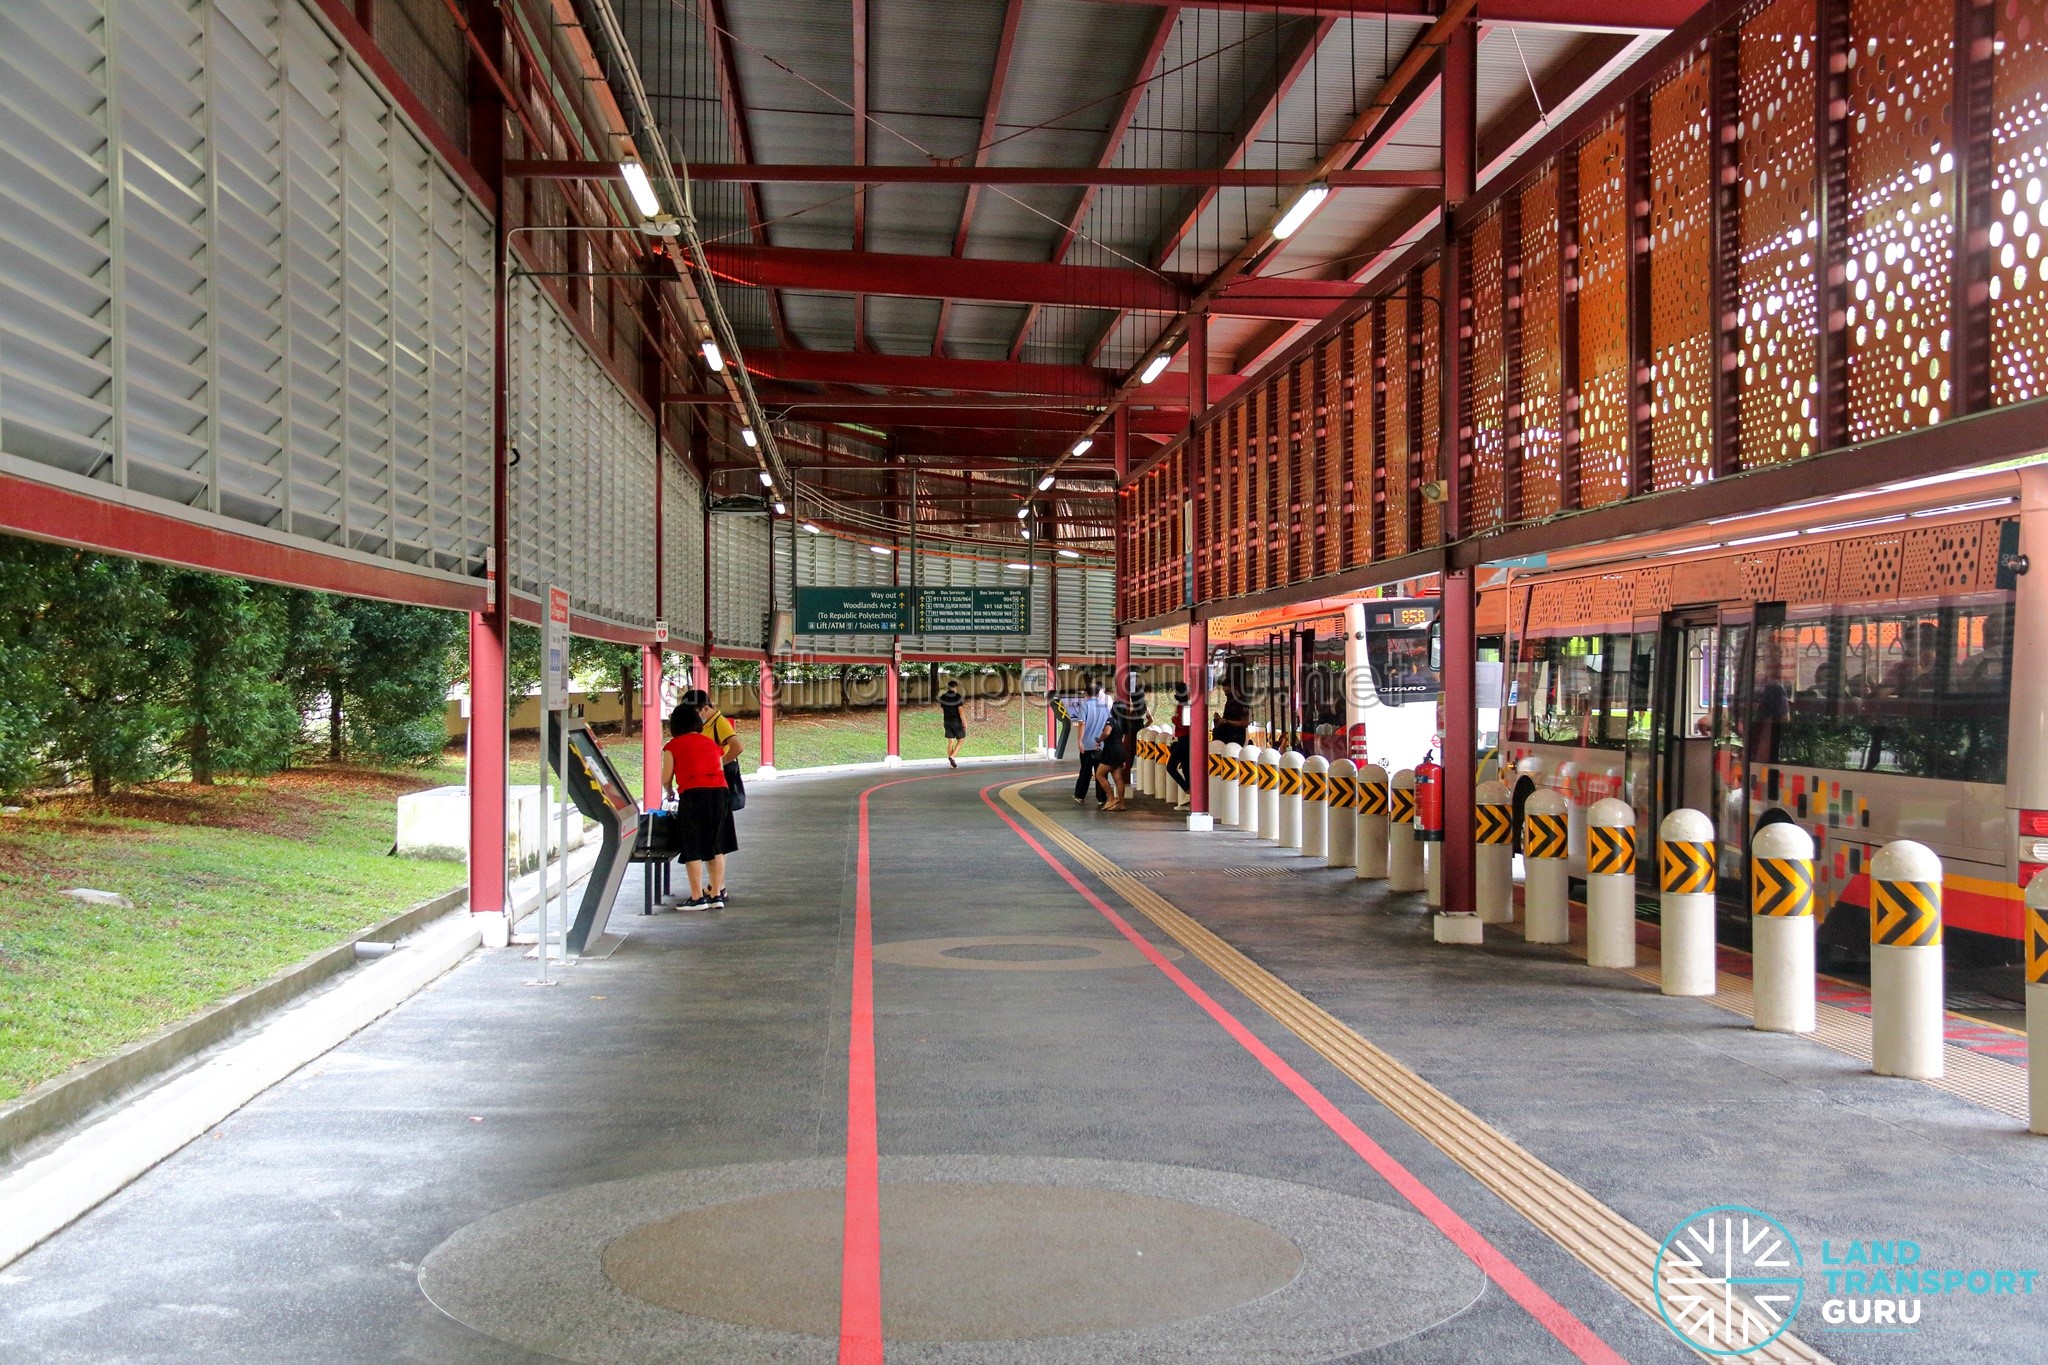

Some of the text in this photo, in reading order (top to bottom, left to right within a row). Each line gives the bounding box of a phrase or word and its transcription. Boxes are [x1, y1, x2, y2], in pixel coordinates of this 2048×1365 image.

[871, 592, 884, 600] Way
[818, 612, 897, 620] (To Republic Polytechnic)
[1401, 609, 1426, 625] 858
[1379, 685, 1427, 693] CITARO
[665, 691, 673, 717] AED
